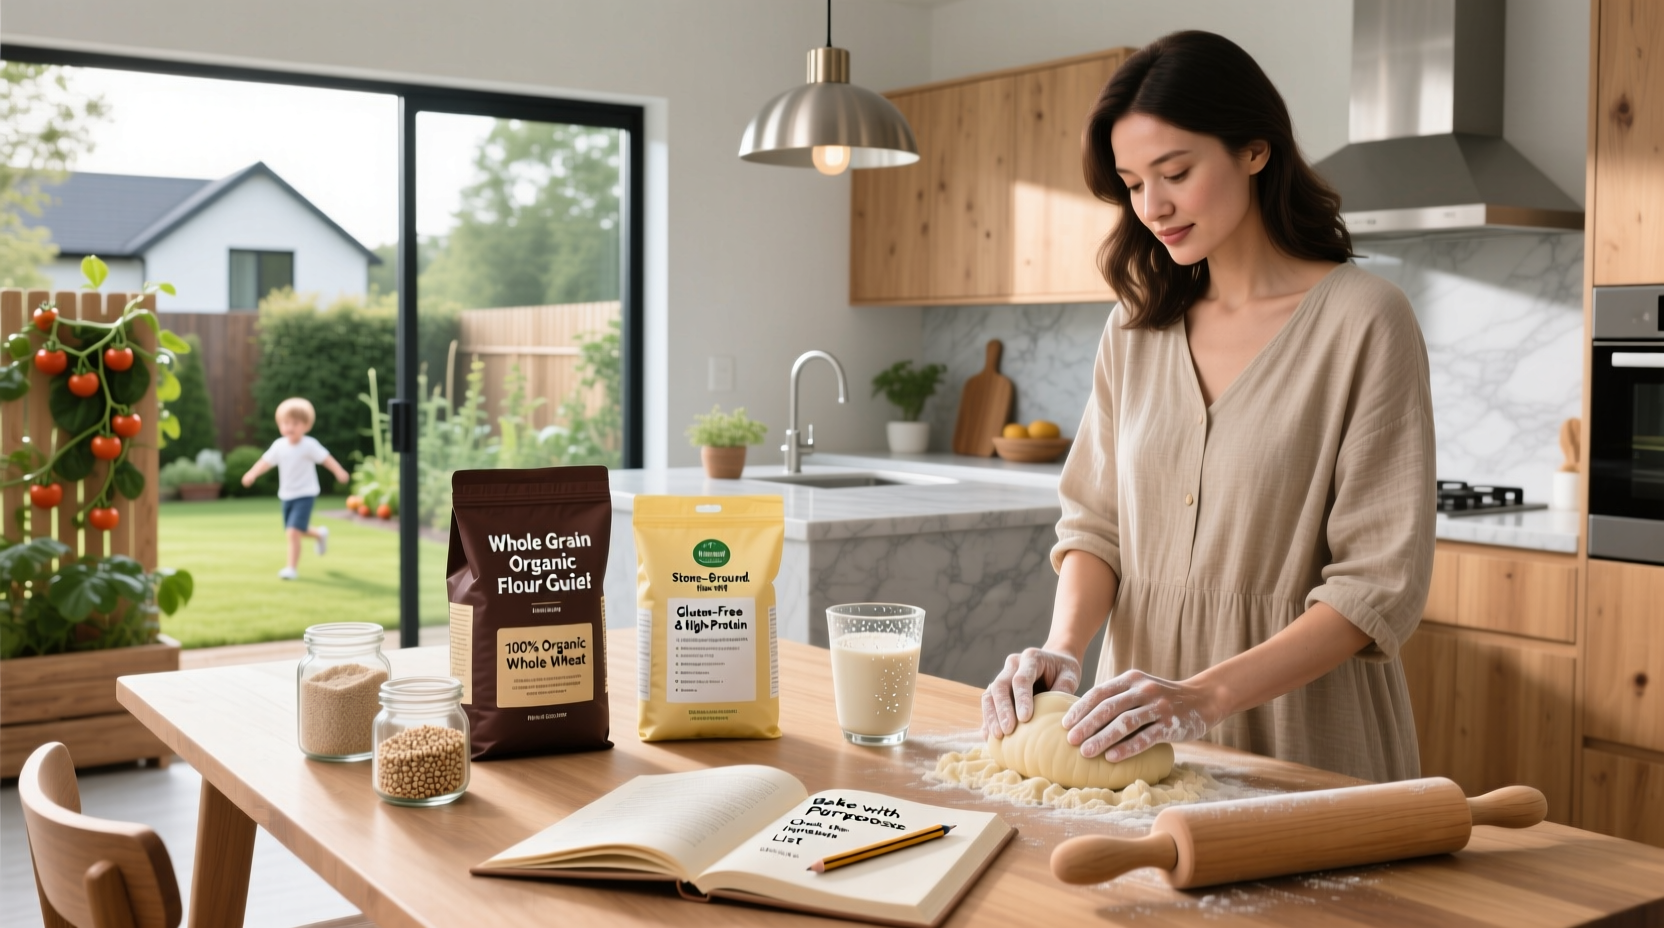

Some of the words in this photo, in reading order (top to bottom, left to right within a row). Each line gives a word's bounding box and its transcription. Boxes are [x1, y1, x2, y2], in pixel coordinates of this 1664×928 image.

[488, 533, 542, 552] Whole
[545, 532, 591, 549] Grain
[509, 552, 577, 575] Organic
[498, 576, 542, 594] Flour
[505, 640, 539, 654] 100%
[542, 637, 586, 654] Organic
[507, 656, 547, 670] Whole
[863, 805, 900, 818] with
